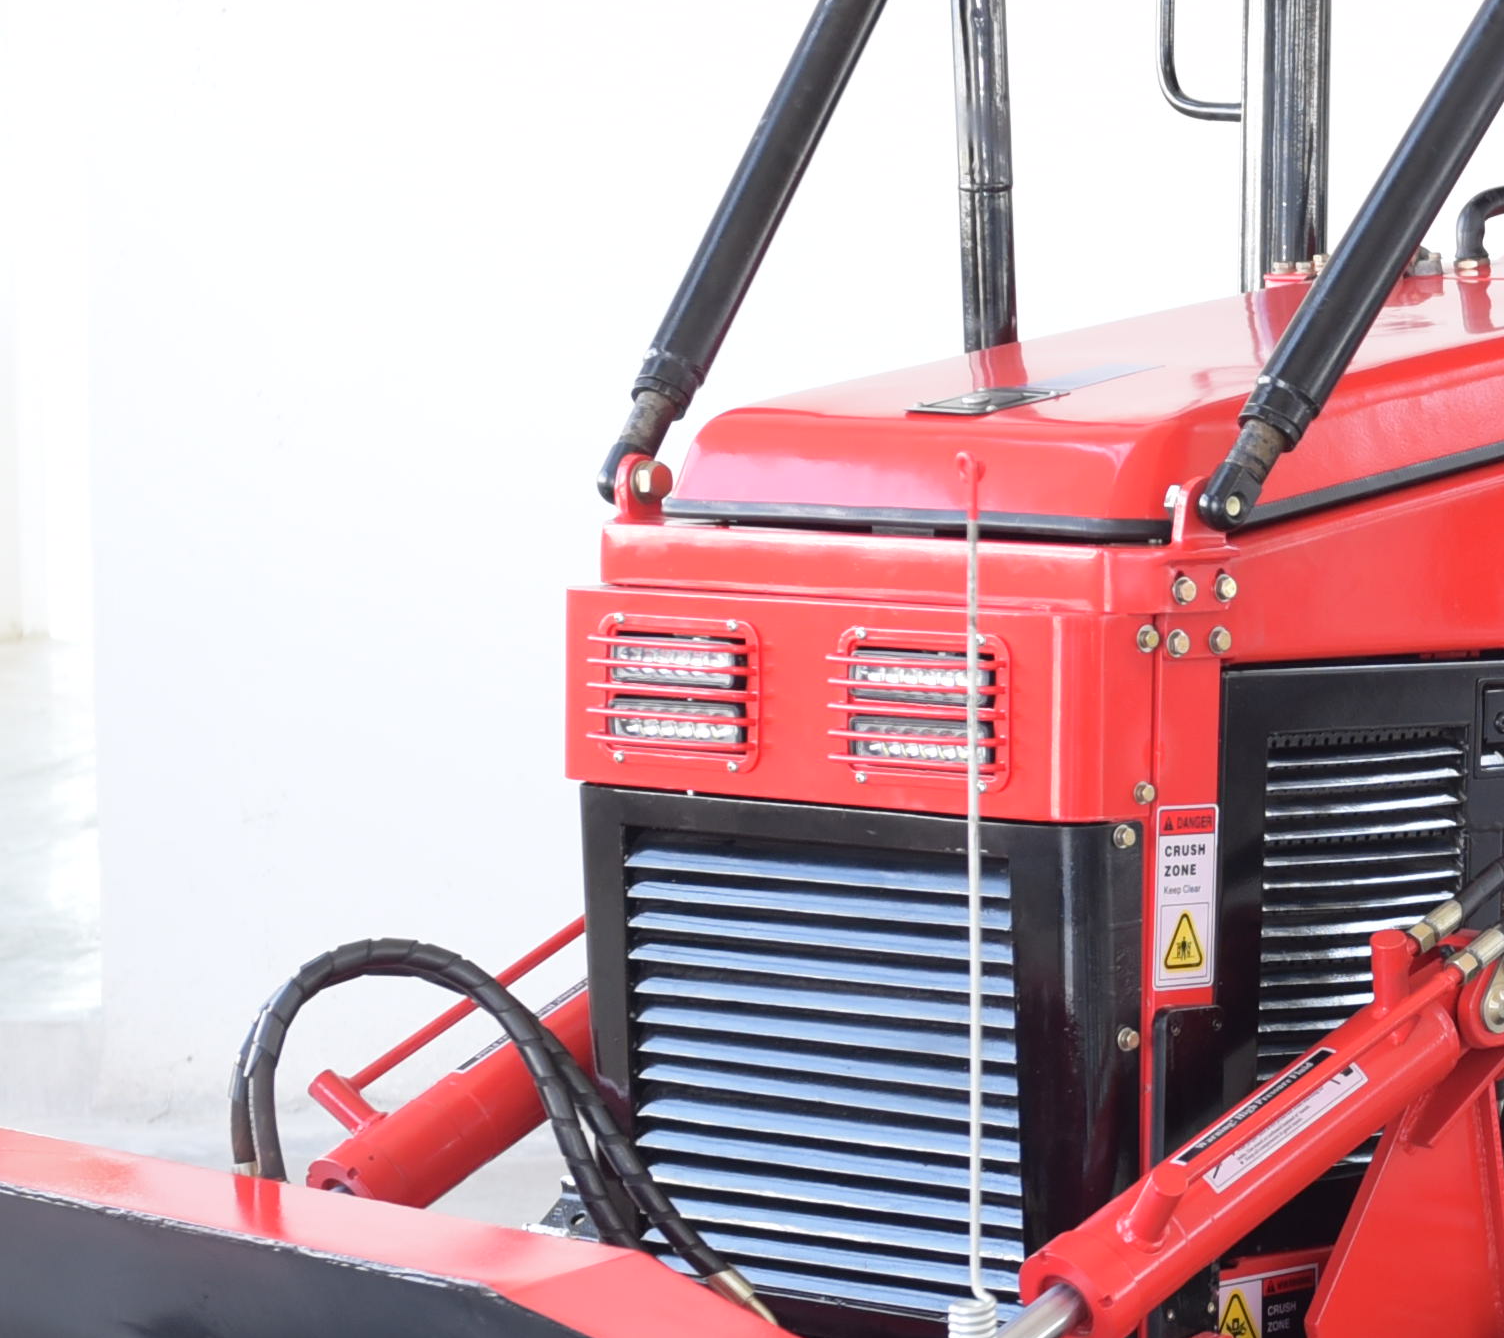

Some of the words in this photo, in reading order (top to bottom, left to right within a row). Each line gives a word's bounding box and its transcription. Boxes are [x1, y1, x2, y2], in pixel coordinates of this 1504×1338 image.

[1176, 815, 1213, 830] DANGER
[1164, 843, 1206, 858] CRUSH
[1164, 863, 1197, 878] ZONE
[1163, 885, 1182, 895] Keep
[1182, 884, 1201, 894] Clear
[1267, 1301, 1297, 1317] CRUSH
[1266, 1318, 1290, 1333] ZONE
